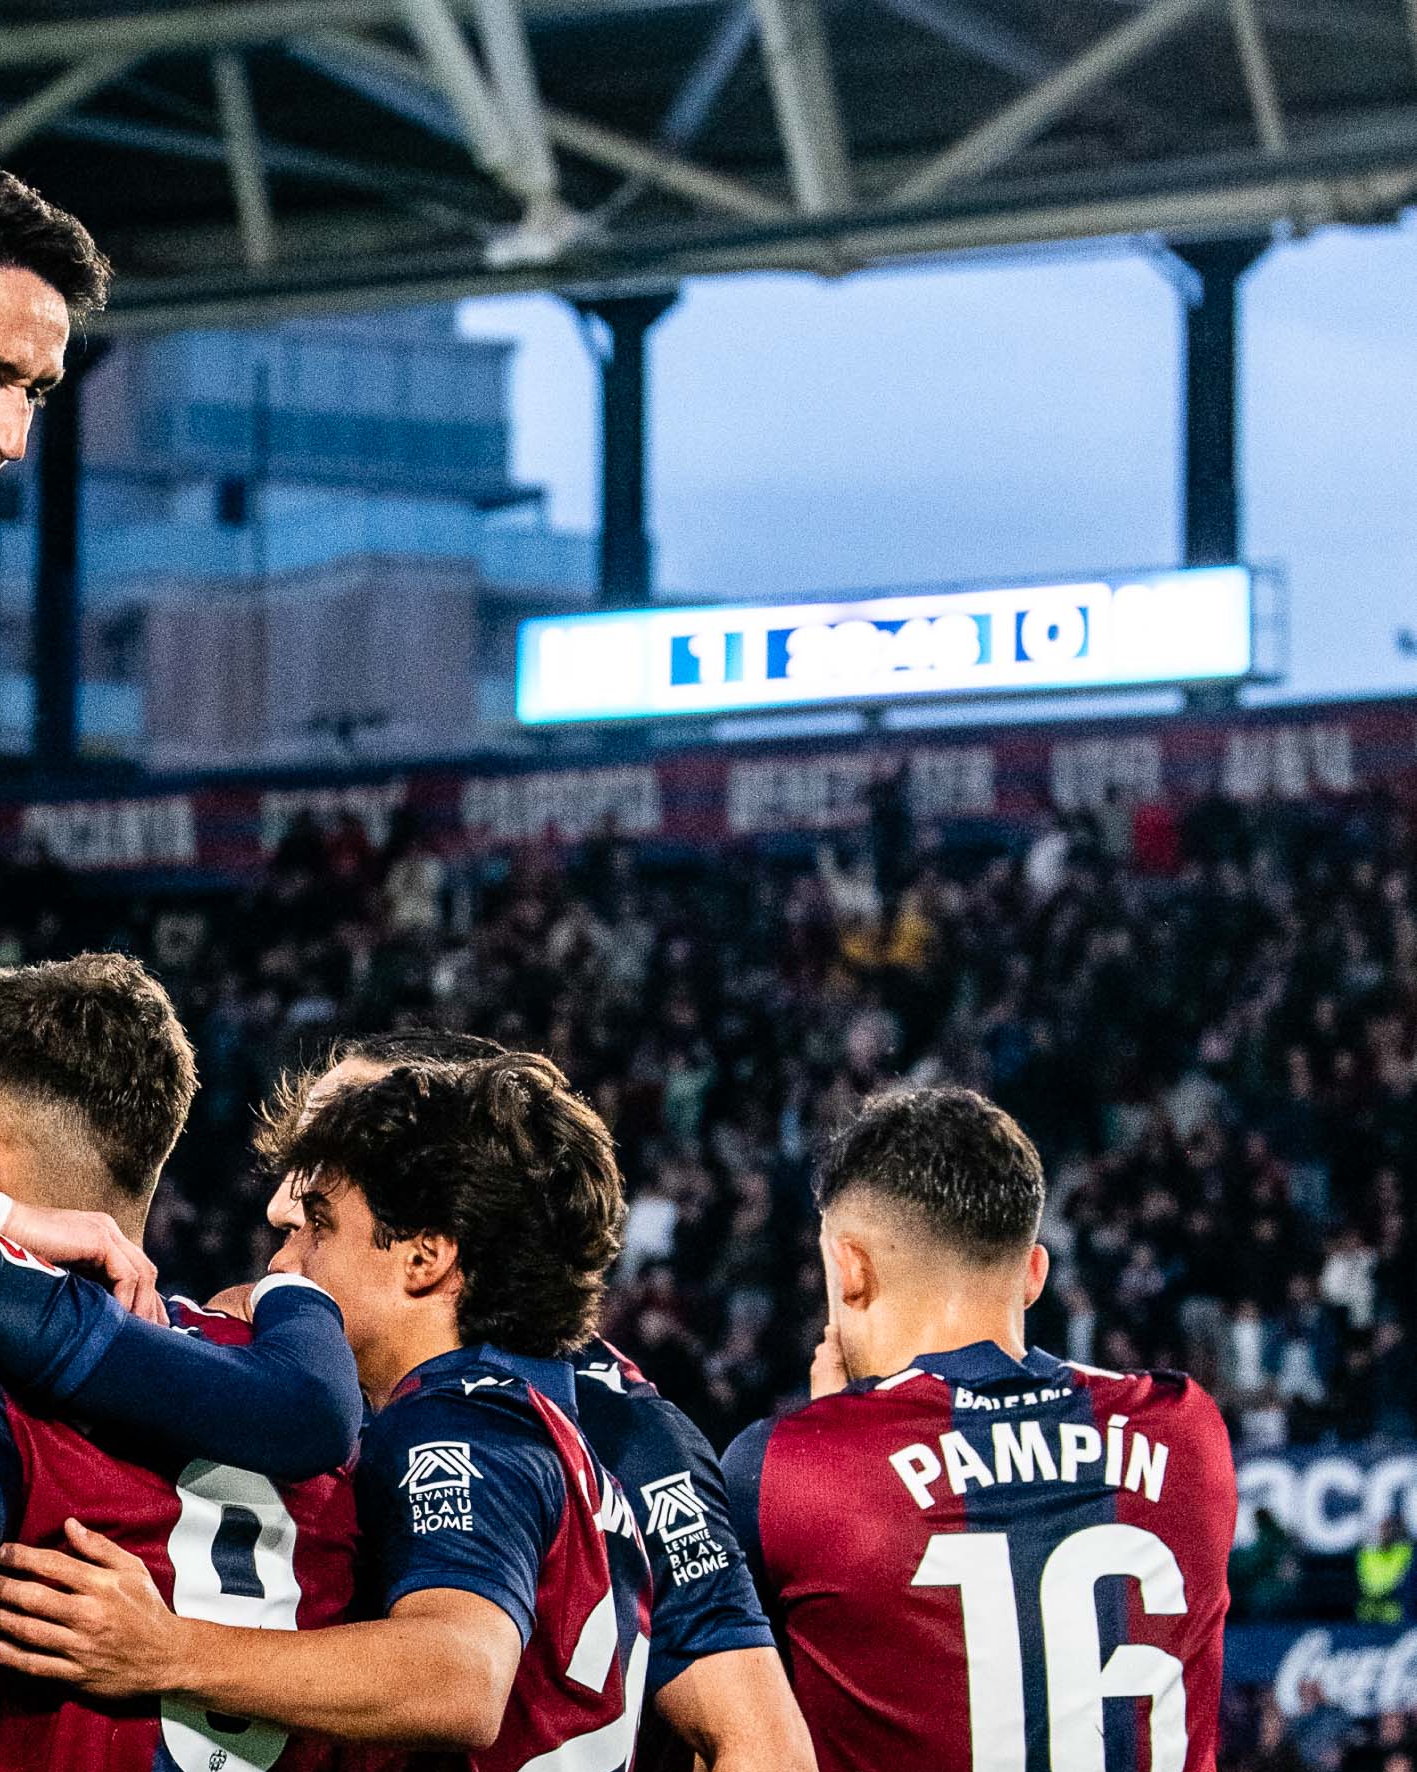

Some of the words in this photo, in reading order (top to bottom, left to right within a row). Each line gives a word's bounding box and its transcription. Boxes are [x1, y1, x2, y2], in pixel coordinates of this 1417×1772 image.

[890, 1414, 1170, 1509] PAMPÍN
[409, 1487, 470, 1504] LEVANTE
[412, 1497, 472, 1520] BLAU
[413, 1515, 473, 1534] HOME
[672, 1551, 730, 1587] HOME
